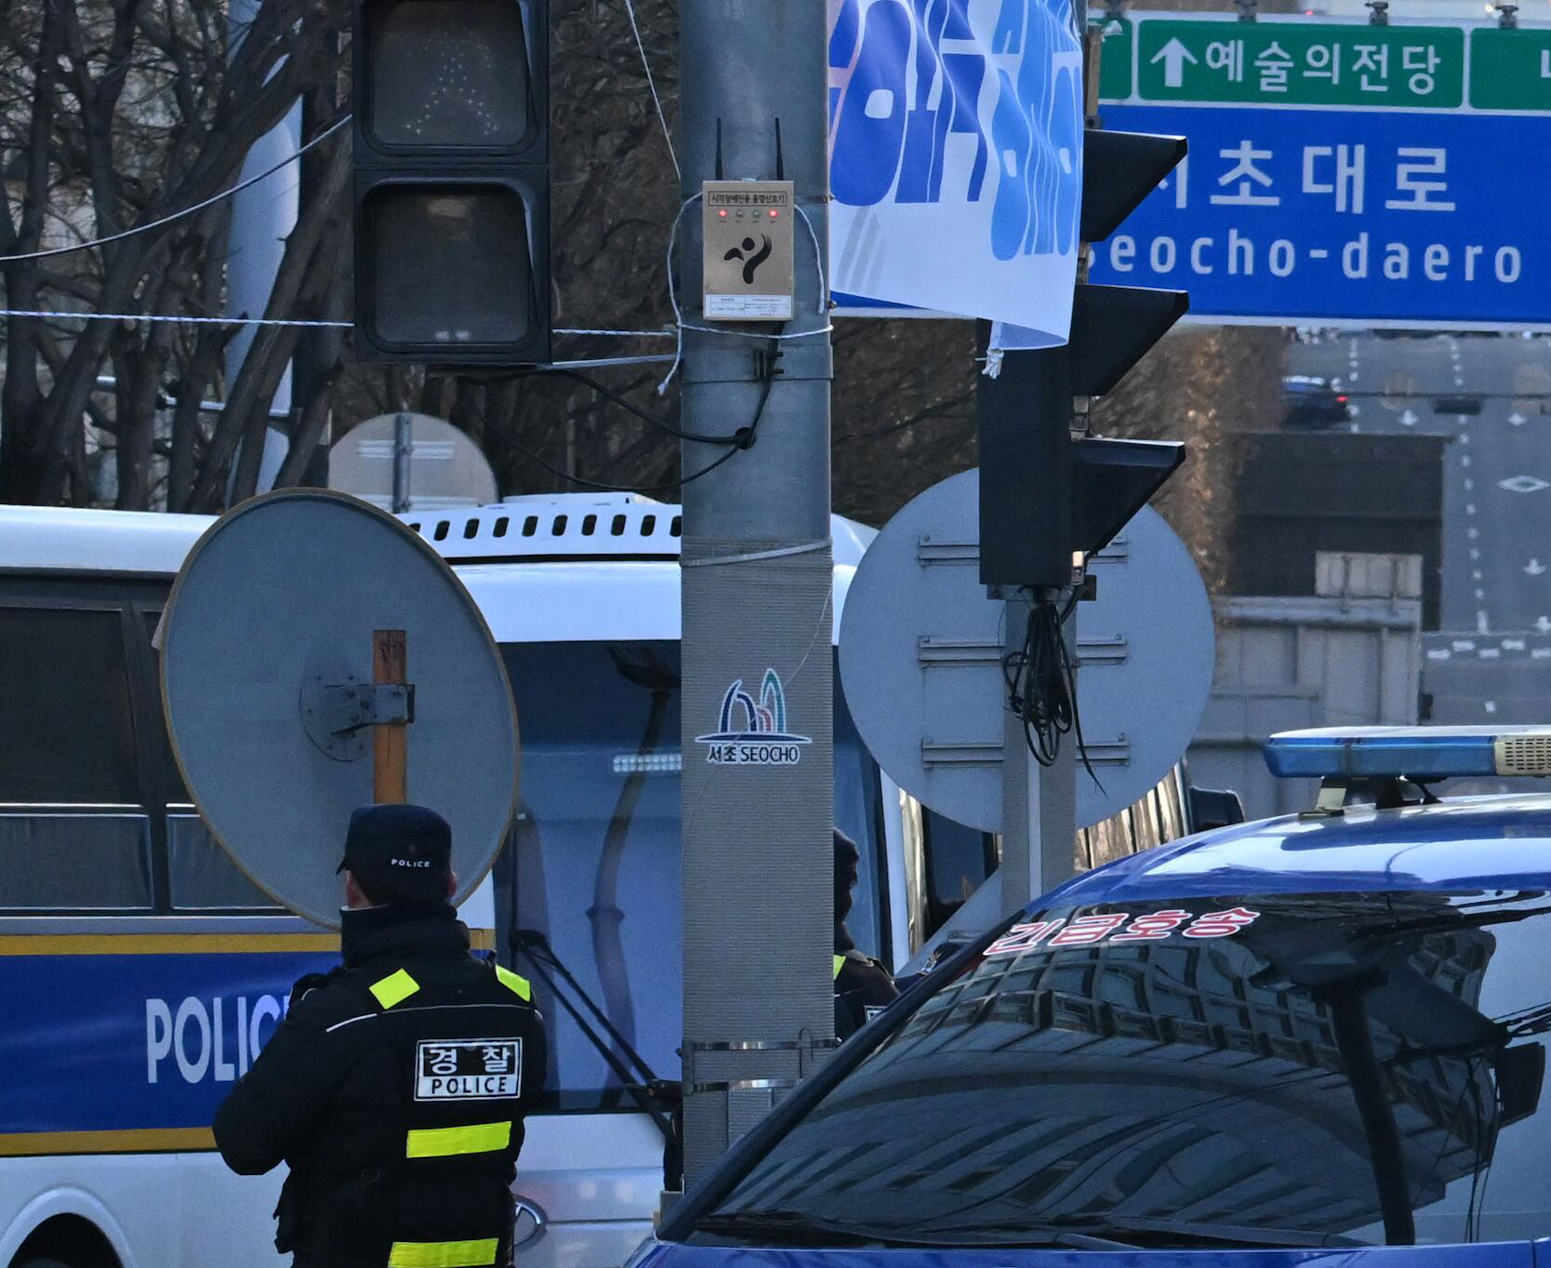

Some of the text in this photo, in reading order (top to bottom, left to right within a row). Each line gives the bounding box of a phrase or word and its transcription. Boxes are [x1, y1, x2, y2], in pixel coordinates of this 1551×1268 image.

[1205, 39, 1441, 95] 예술의전당
[1087, 228, 1522, 283] eocho-daero
[740, 746, 798, 762] SEOCHO
[391, 858, 430, 867] POLICE
[983, 907, 1260, 955] 긴급호송
[145, 994, 290, 1084] POLIC
[429, 1046, 511, 1075] 경찰
[431, 1076, 507, 1095] POLICE
